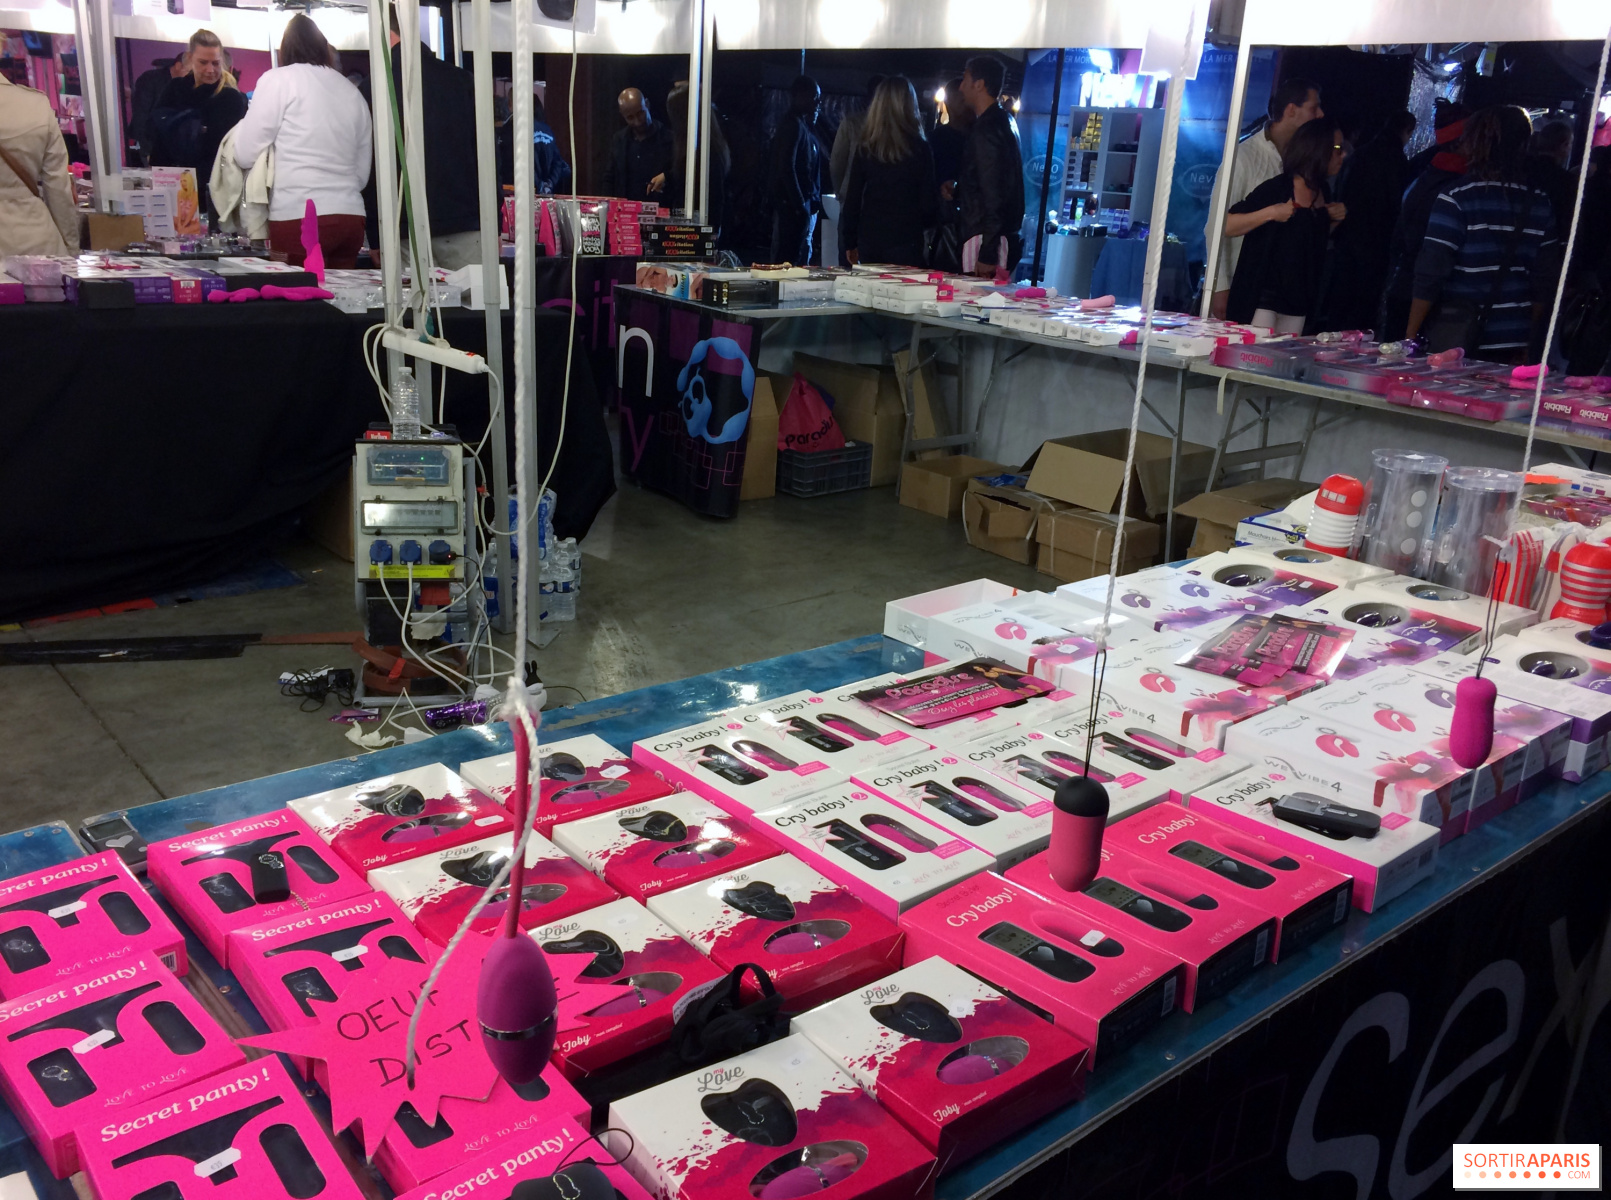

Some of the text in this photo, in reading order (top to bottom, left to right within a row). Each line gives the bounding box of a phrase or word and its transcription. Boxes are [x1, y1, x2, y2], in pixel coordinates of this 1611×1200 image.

[1544, 402, 1572, 414] Rabbit
[1580, 409, 1609, 421] Rabbit
[1298, 770, 1329, 786] VIBE
[1331, 782, 1342, 792] 4
[536, 812, 559, 824] Toby
[168, 830, 219, 854] Secret
[1138, 825, 1168, 845] Cry
[362, 853, 388, 867] Toby
[640, 877, 664, 892] Toby
[947, 906, 980, 928] Cry
[251, 917, 317, 943] Secret
[539, 920, 582, 941] Love
[861, 982, 900, 1006] Love
[562, 1032, 592, 1053] Toby
[103, 1087, 135, 1108] LOVE
[159, 1067, 188, 1086] LOVE
[697, 1065, 746, 1093] Love
[101, 1101, 183, 1144] Secret
[933, 1101, 961, 1123] Toby
[464, 1134, 491, 1153] LOVE
[513, 1114, 539, 1132] LOVE
